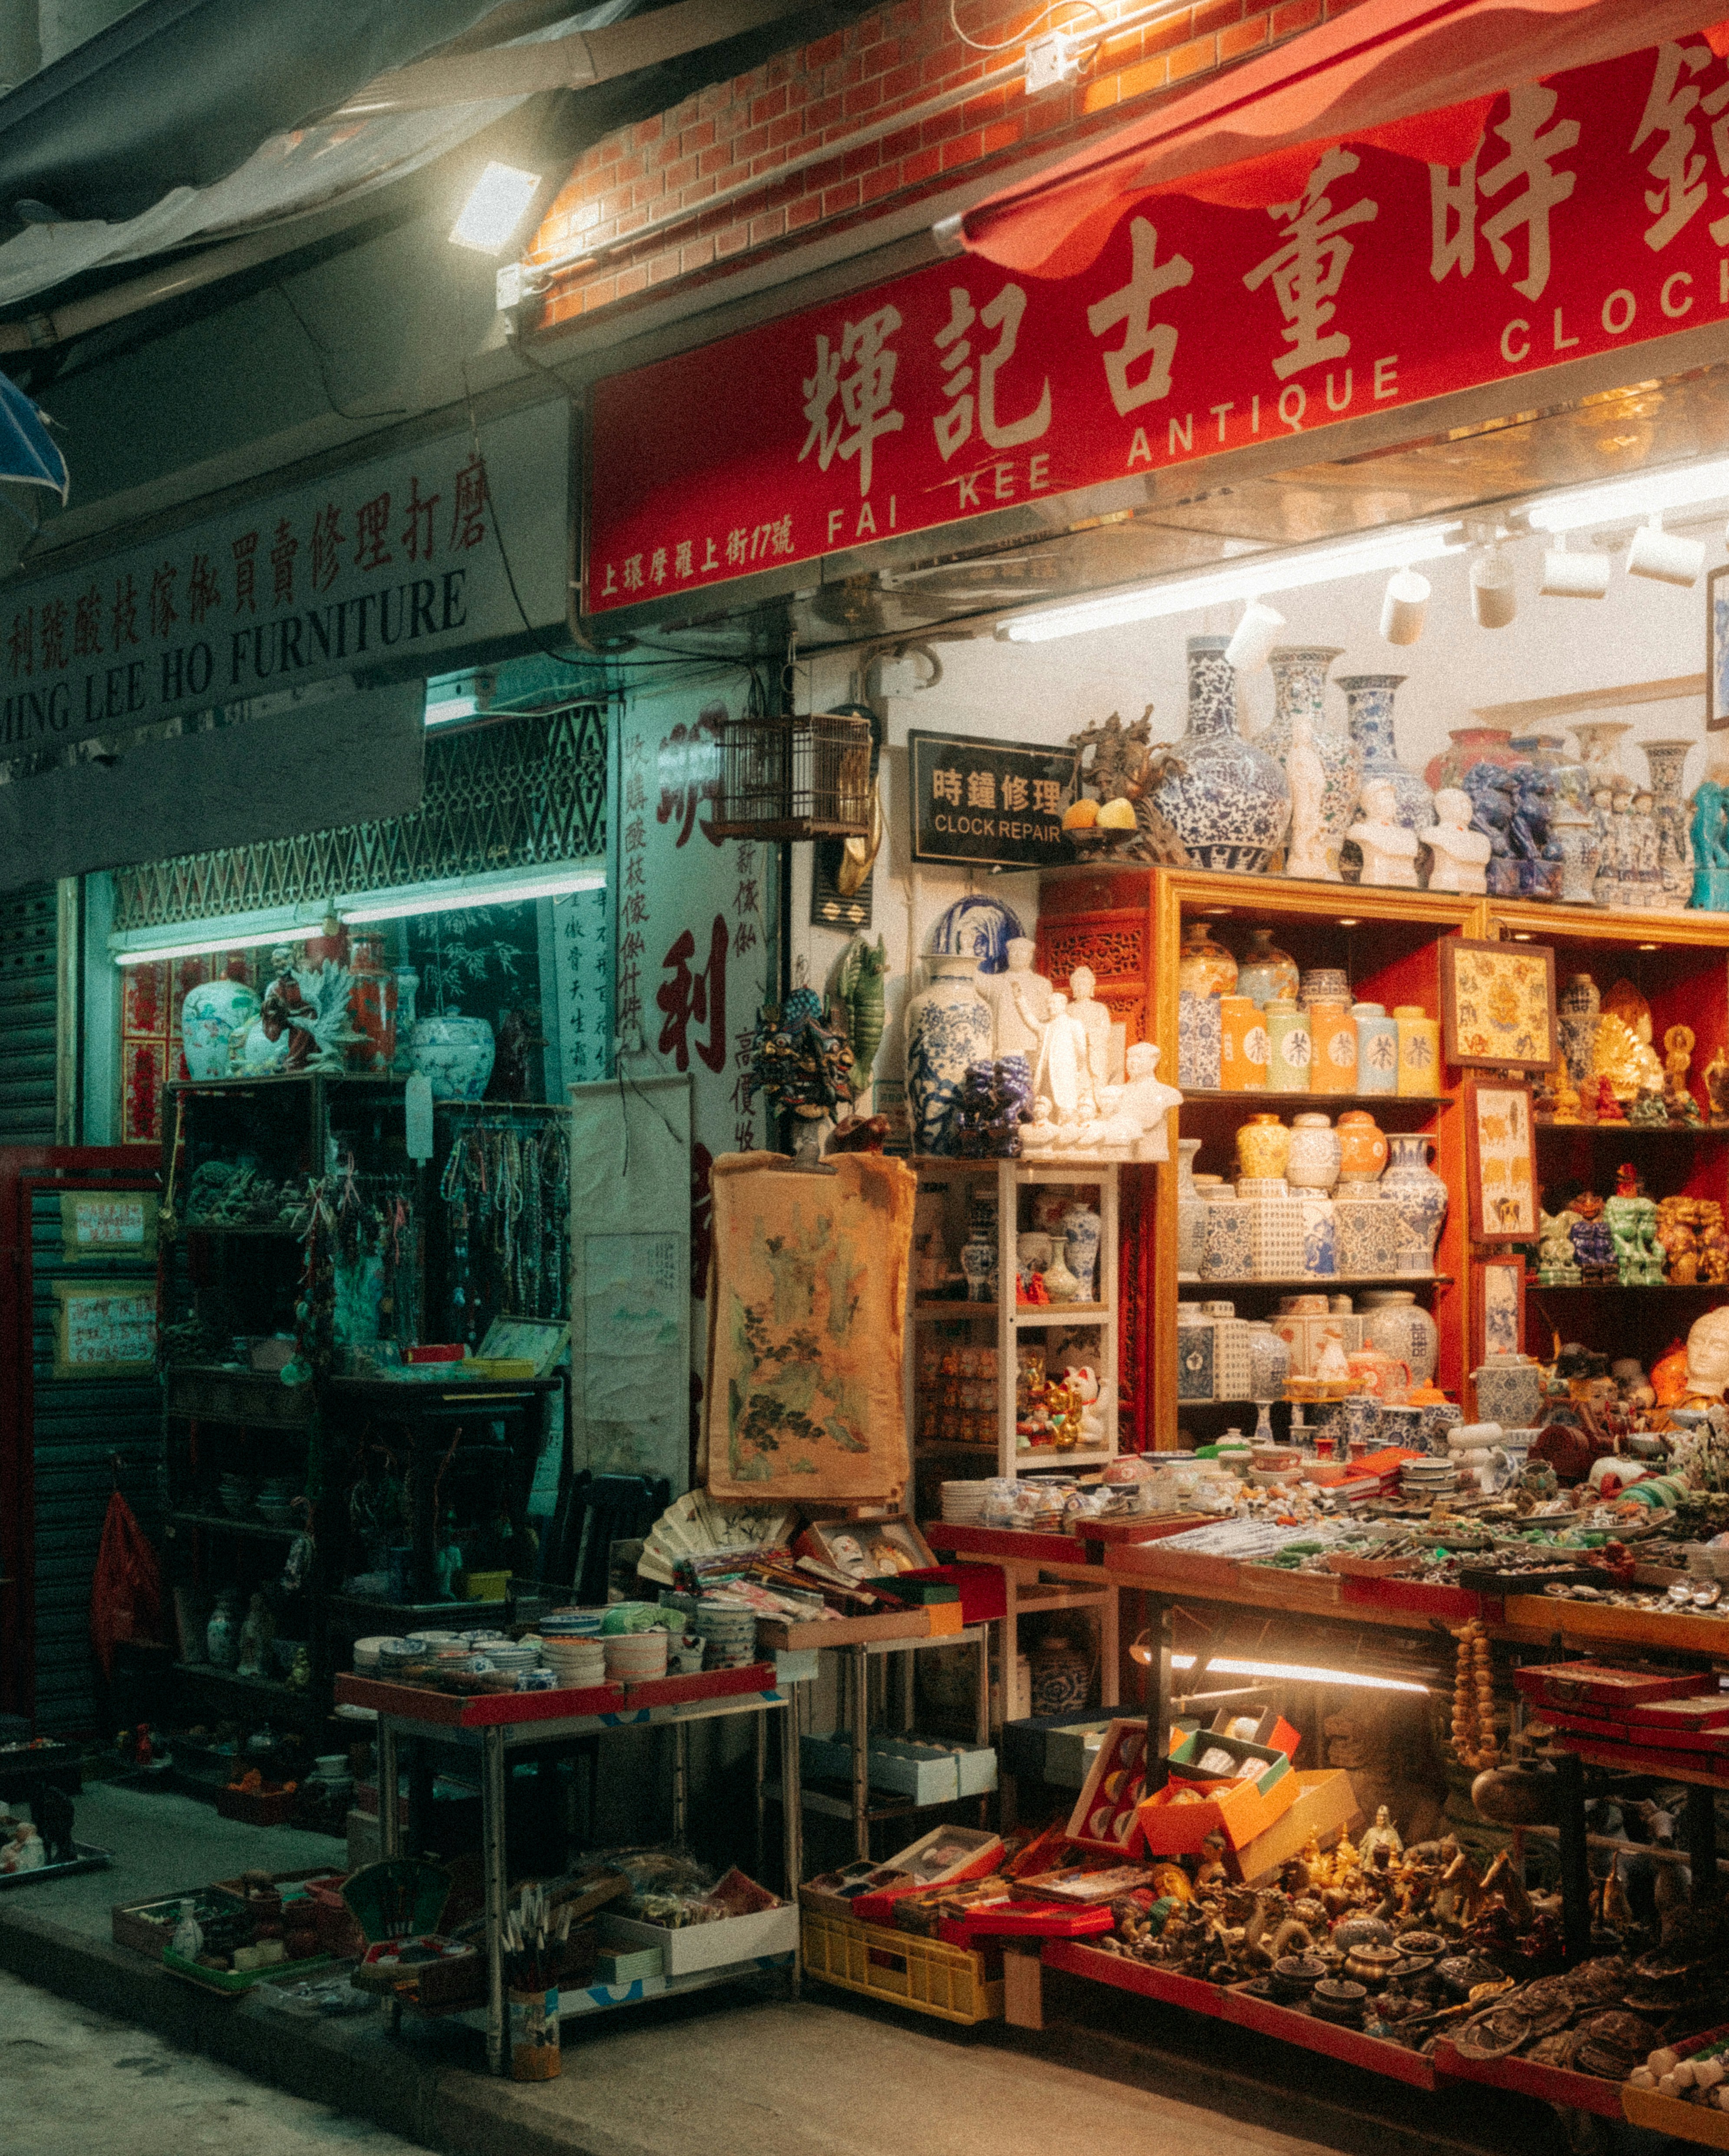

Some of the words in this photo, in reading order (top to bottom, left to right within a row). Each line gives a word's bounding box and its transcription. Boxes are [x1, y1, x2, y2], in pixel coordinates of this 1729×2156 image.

[827, 494, 897, 543] FAI
[959, 454, 1050, 508] KEE
[1126, 355, 1398, 467] ANTIQUE
[86, 660, 145, 722] LEE
[162, 641, 213, 703] HO
[230, 568, 467, 686] FURNITURE
[933, 768, 1061, 816] 時鐘修理
[935, 813, 995, 837] CLOCK
[998, 819, 1061, 843] REPAIR
[1290, 1032, 1308, 1065] 茶
[1372, 1036, 1394, 1068] 茶
